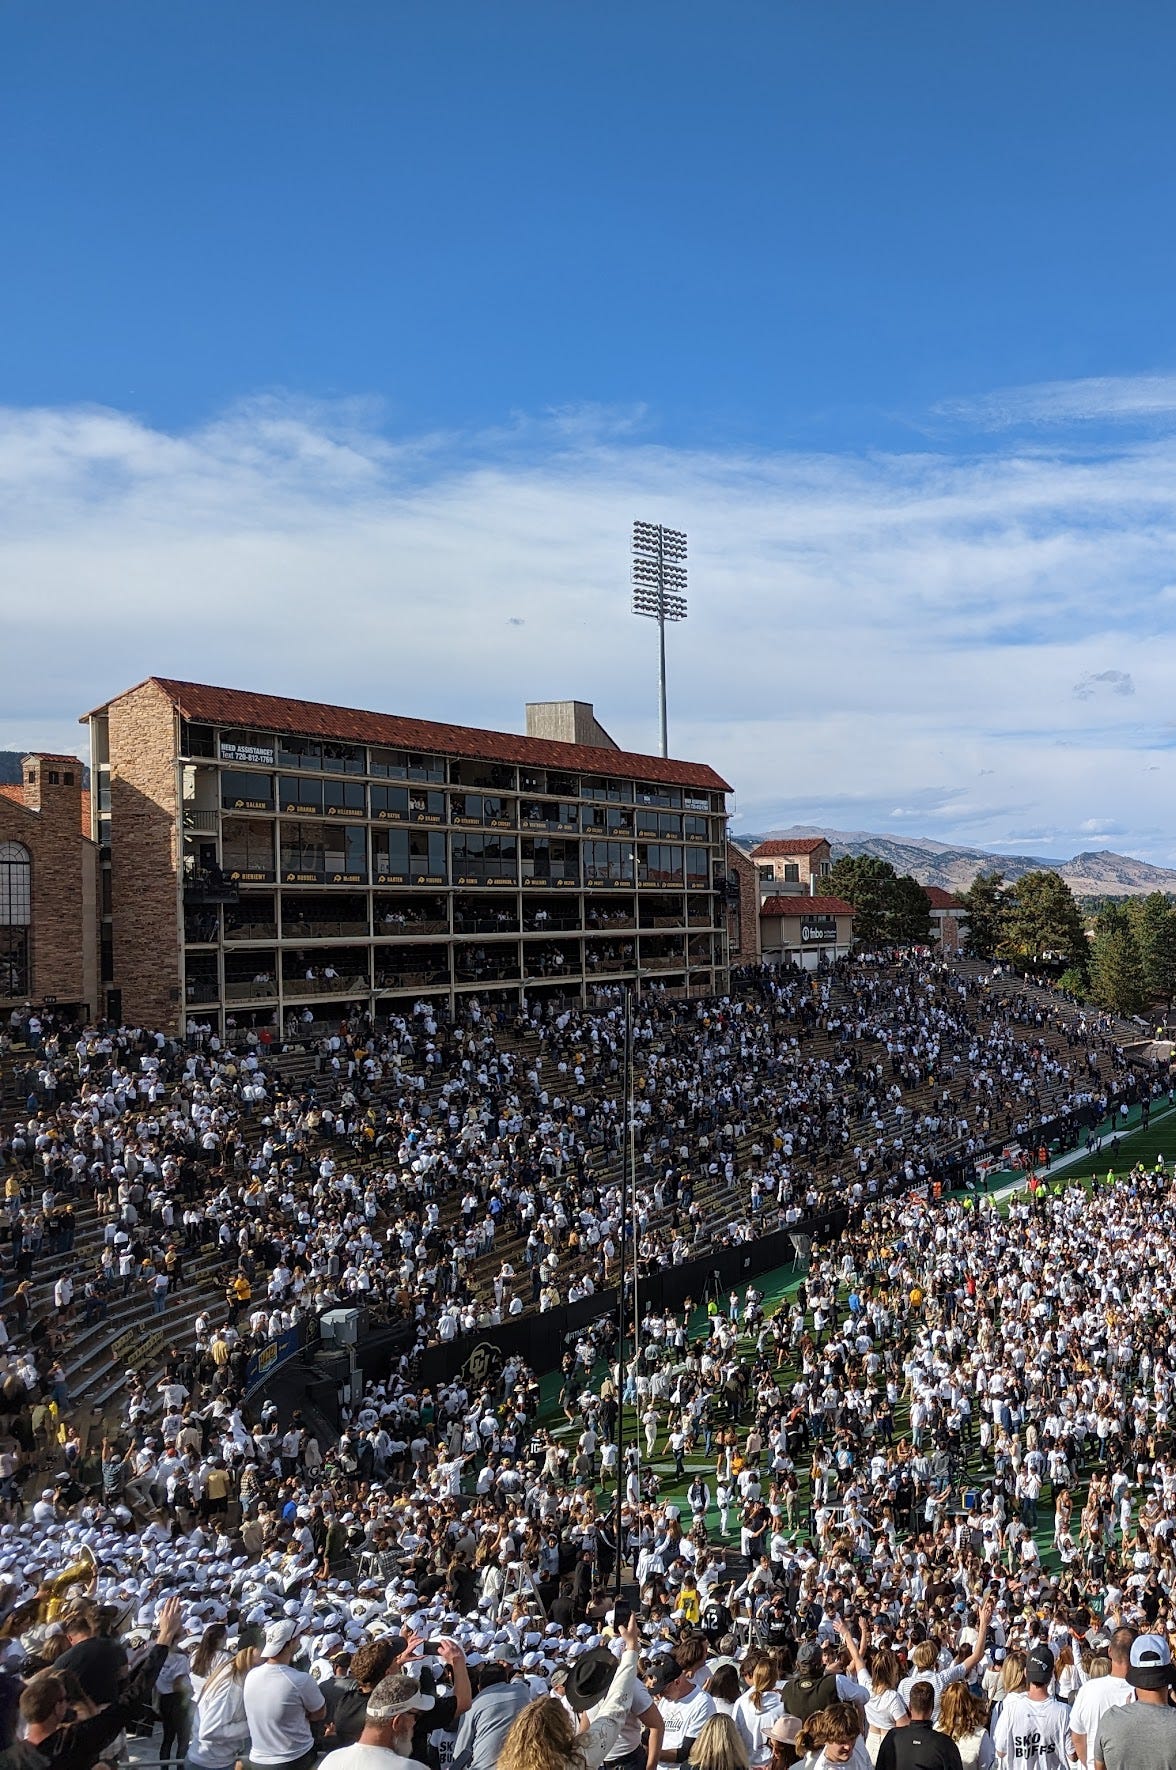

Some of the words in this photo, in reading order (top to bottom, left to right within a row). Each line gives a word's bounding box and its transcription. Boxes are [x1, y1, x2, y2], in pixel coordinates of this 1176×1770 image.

[221, 743, 236, 752] NEED
[221, 750, 234, 759] Text
[810, 927, 823, 939] fnbo
[1015, 1733, 1041, 1746] SKO
[1015, 1743, 1056, 1760] BUFFS
